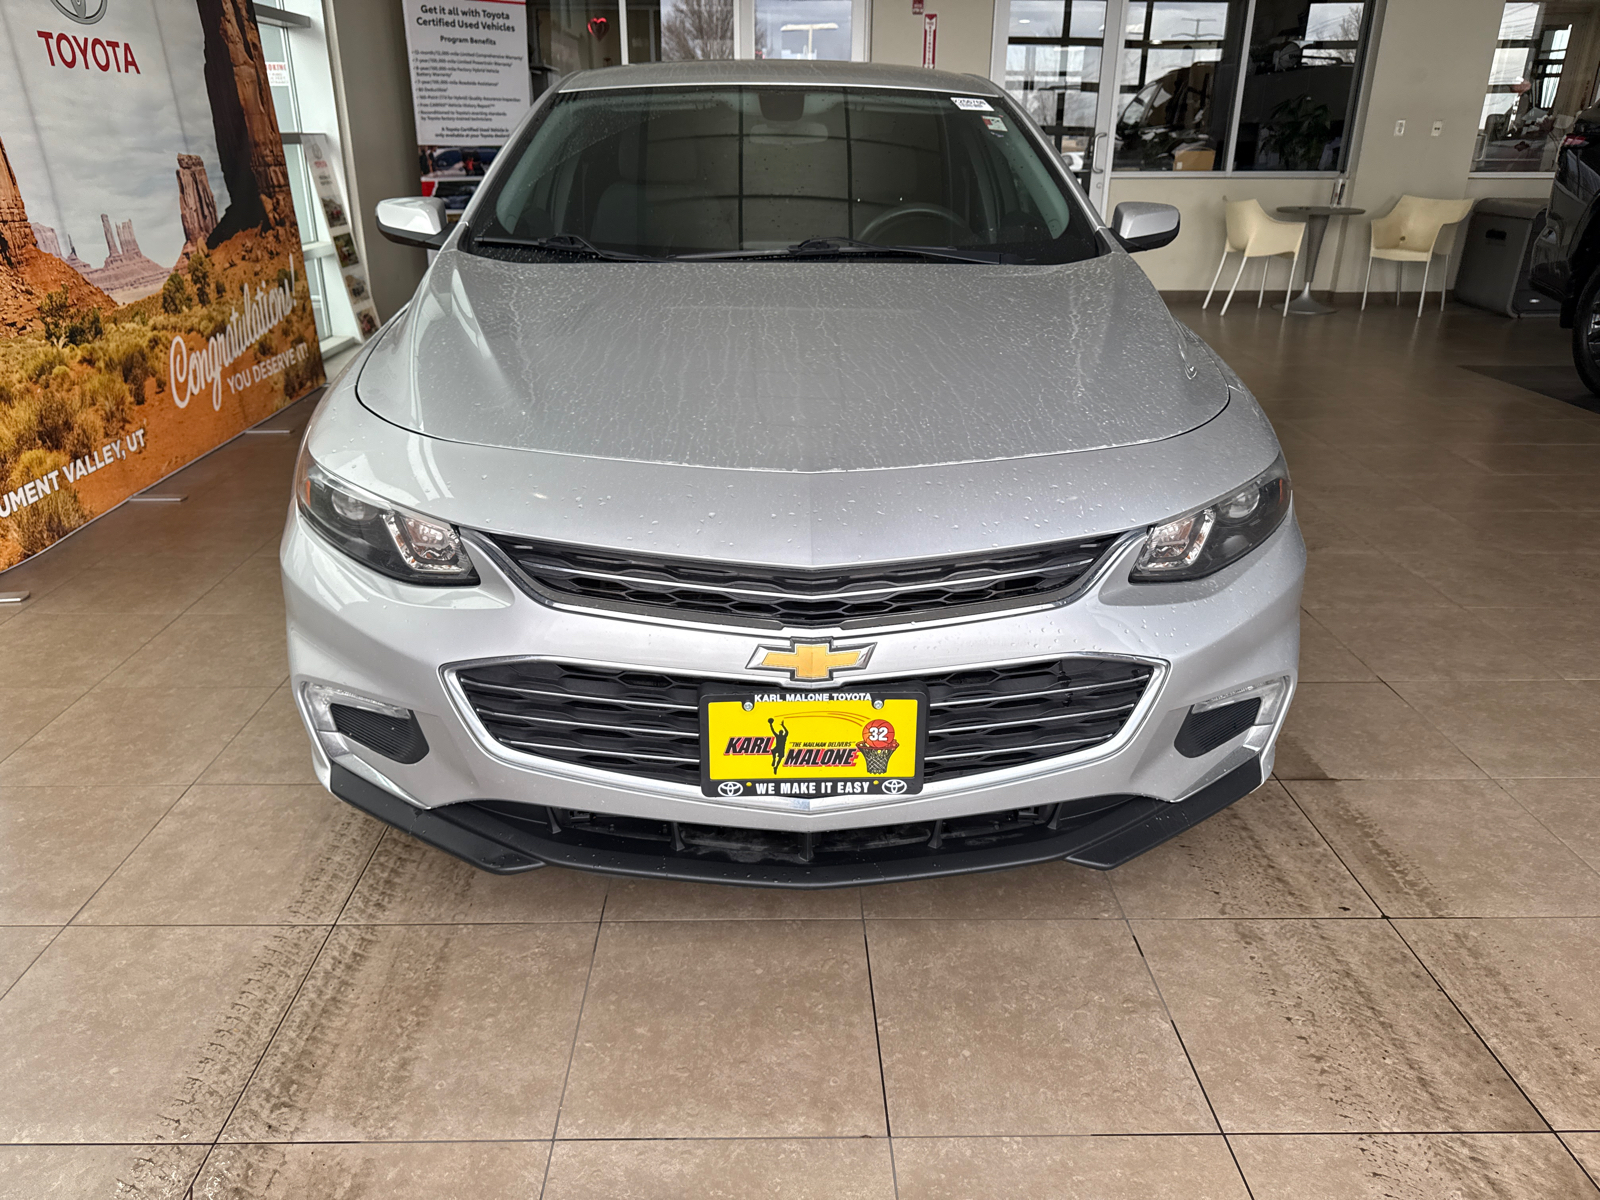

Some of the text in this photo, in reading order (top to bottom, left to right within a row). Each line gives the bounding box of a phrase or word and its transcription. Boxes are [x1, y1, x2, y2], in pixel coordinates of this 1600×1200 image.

[420, 4, 510, 20] Get it all with Toyota
[416, 17, 515, 32] Certified Used Vehicles
[440, 35, 496, 45] Program Benefits
[36, 30, 141, 74] TOYOTA
[170, 253, 297, 411] Congratulations!
[227, 341, 309, 394] YOU DESERVE IT!
[0, 428, 146, 518] UMENT VALLEY, UT
[754, 692, 872, 702] KARL MALONE TOYOTA
[868, 727, 888, 741] 32
[724, 736, 775, 756] KARL
[783, 748, 858, 768] MALONE
[755, 781, 870, 795] WE MAKE IT EASY
